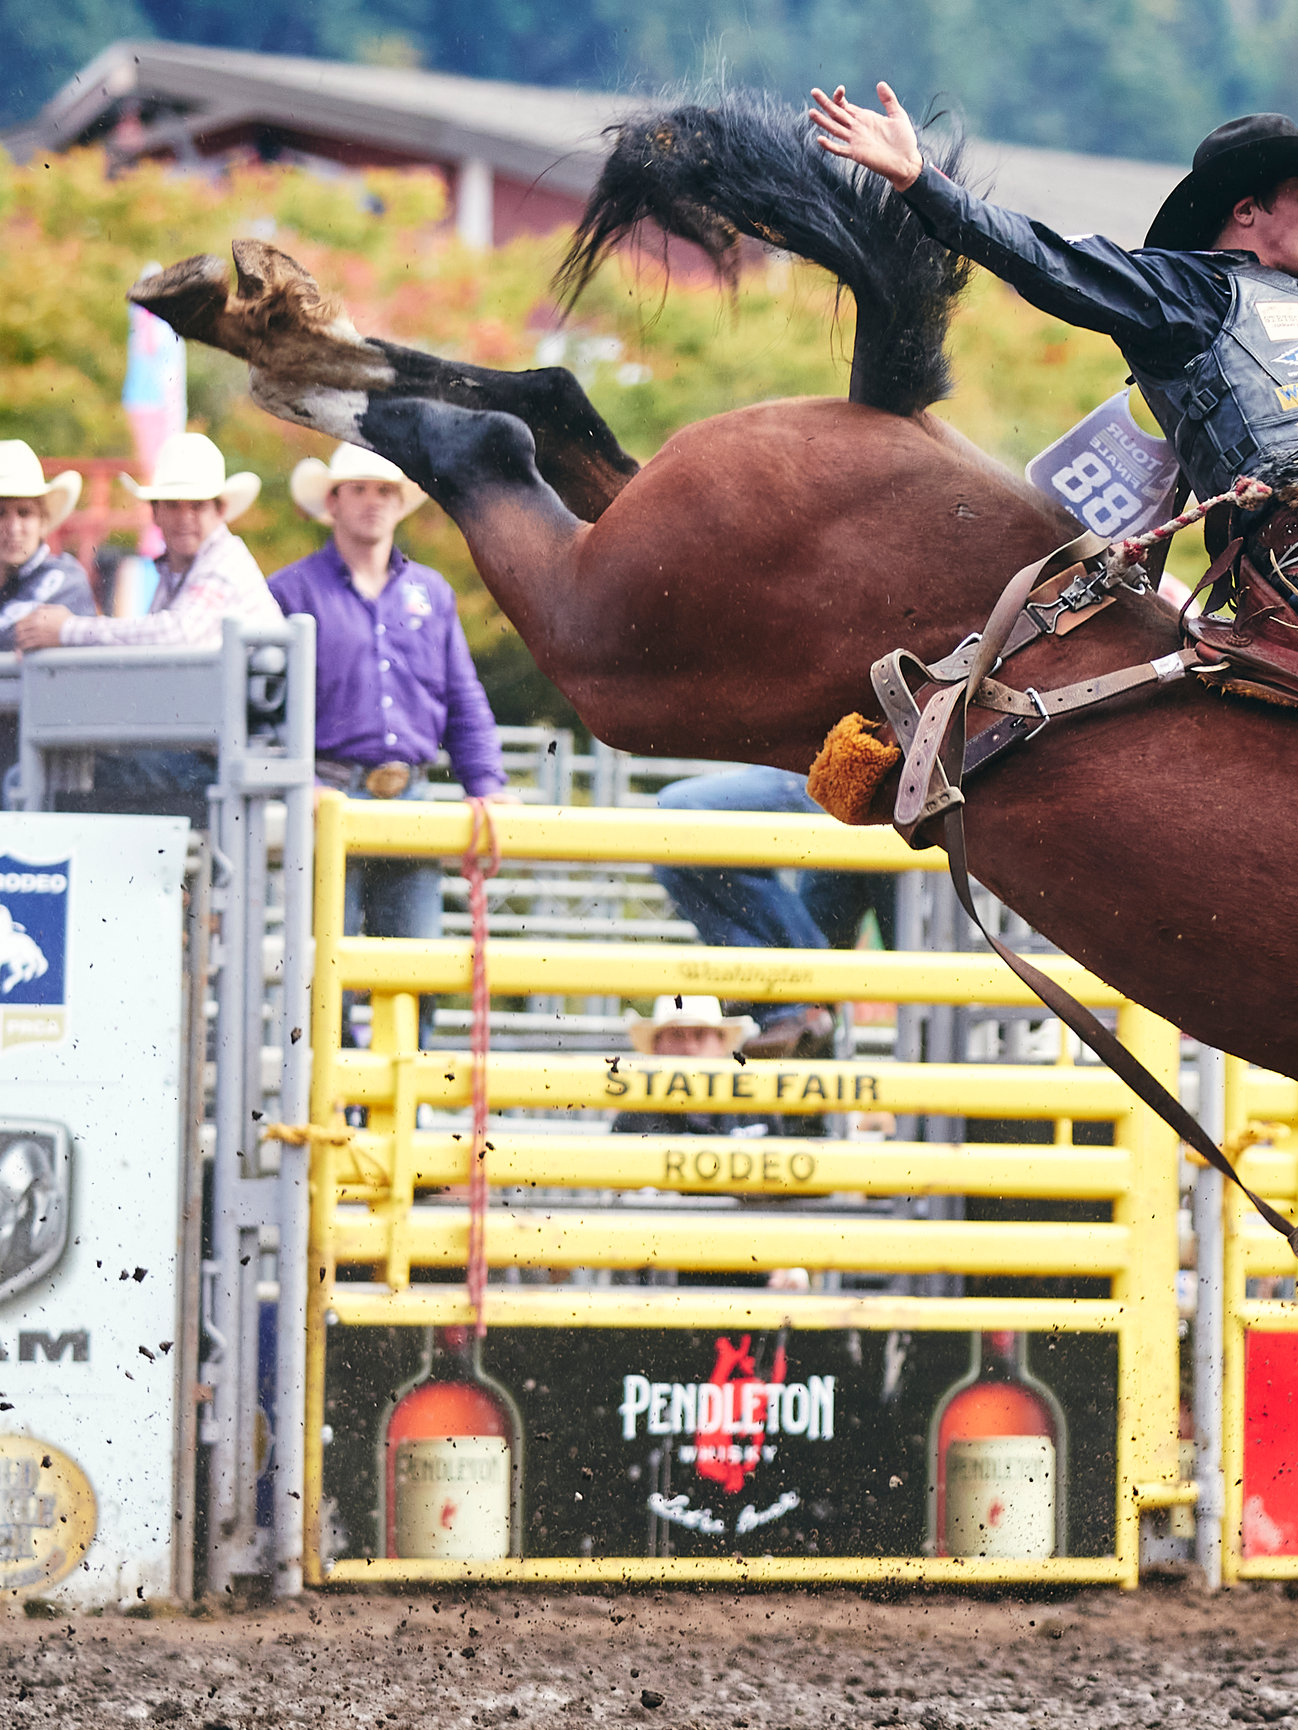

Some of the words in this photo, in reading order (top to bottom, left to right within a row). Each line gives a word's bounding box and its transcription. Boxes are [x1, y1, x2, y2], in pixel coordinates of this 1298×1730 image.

[605, 1070, 755, 1098] STATE
[776, 1073, 881, 1100] FAIR
[664, 1149, 817, 1182] RODEO
[618, 1375, 836, 1440] PENDLETON
[678, 1444, 776, 1464] WHISKY
